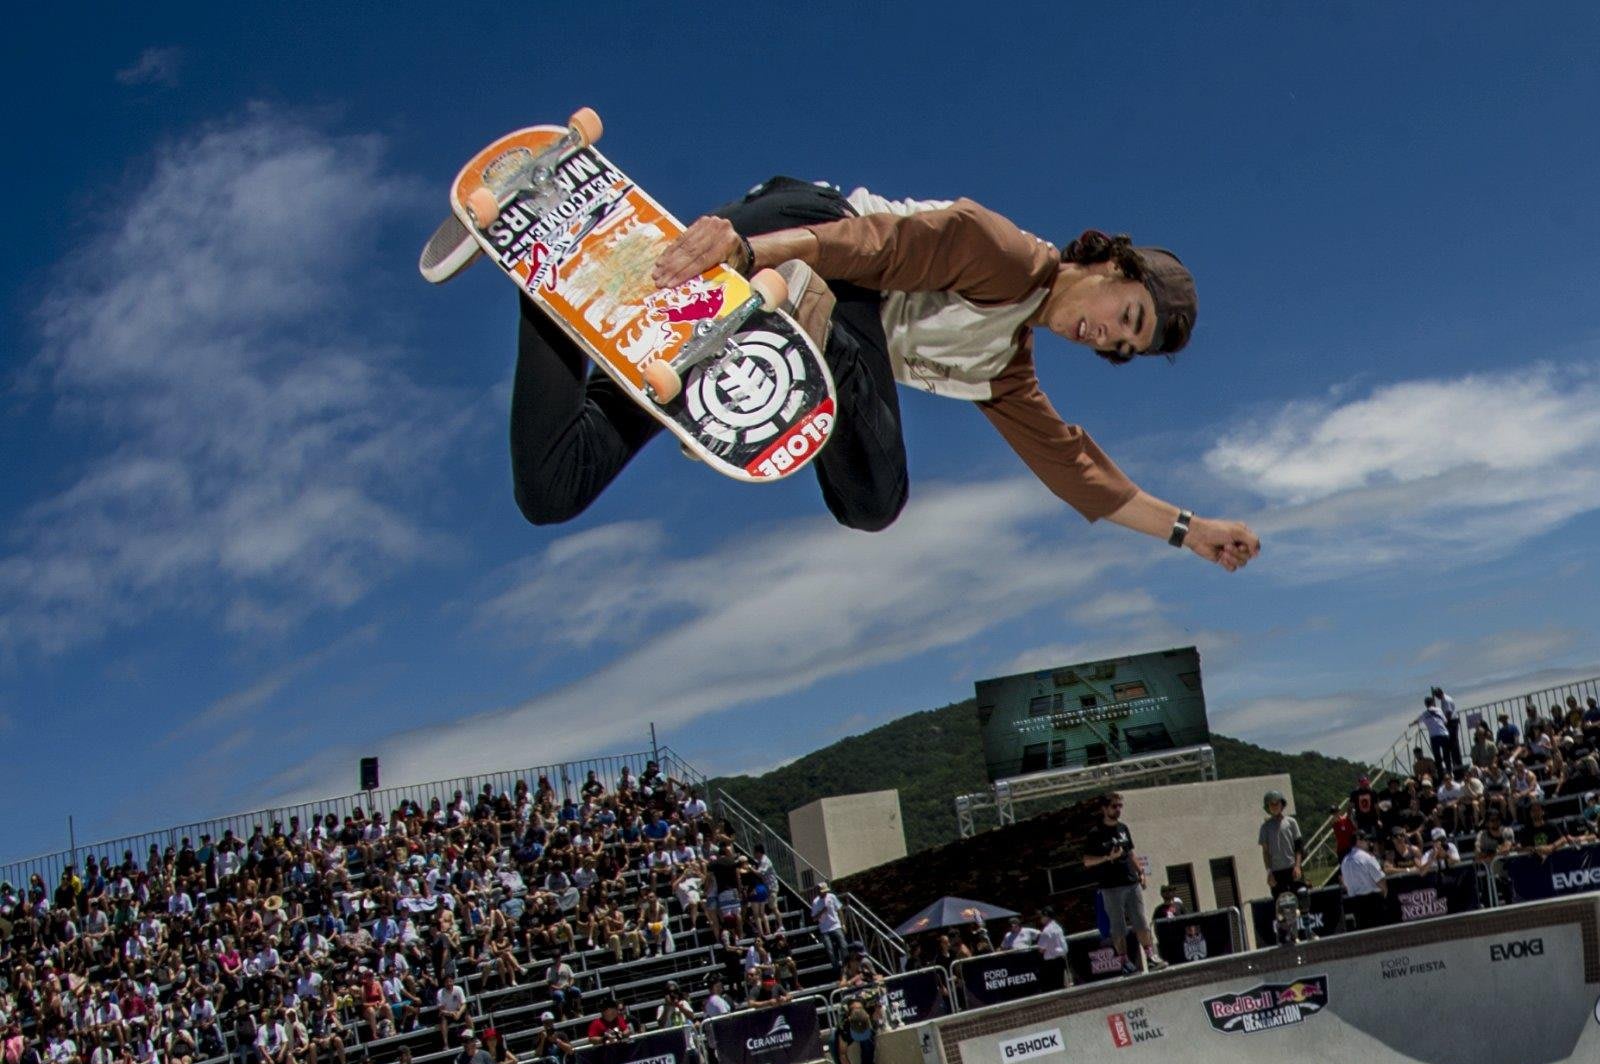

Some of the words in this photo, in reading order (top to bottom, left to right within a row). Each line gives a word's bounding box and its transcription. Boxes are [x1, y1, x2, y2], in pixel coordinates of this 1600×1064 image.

[757, 413, 834, 478] GLOBE
[1381, 956, 1410, 969] FORD
[1382, 967, 1407, 980] NEW
[1409, 959, 1447, 975] FIESTA
[983, 968, 1009, 980] FORD
[986, 979, 1007, 990] NEW
[1007, 973, 1037, 986] FIESTA
[1130, 1020, 1149, 1031] THE
[746, 1031, 793, 1051] CERANIUM
[1004, 1034, 1058, 1058] G-SHOCK
